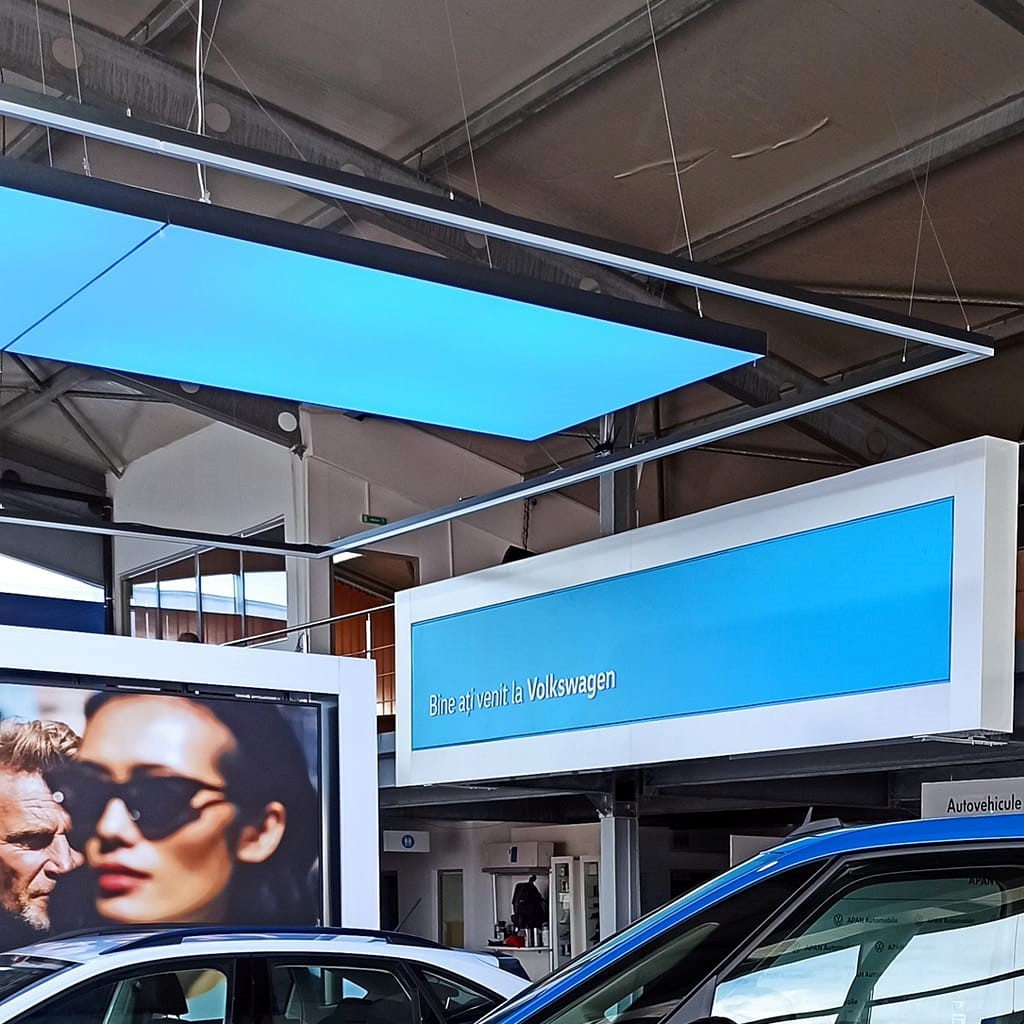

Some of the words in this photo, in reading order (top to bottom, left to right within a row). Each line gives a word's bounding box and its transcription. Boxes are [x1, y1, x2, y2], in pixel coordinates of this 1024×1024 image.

[429, 693, 456, 716] Bine
[477, 681, 509, 709] venit
[511, 680, 524, 705] la
[527, 670, 616, 699] Volkswagen
[947, 793, 1021, 813] Autovehicule
